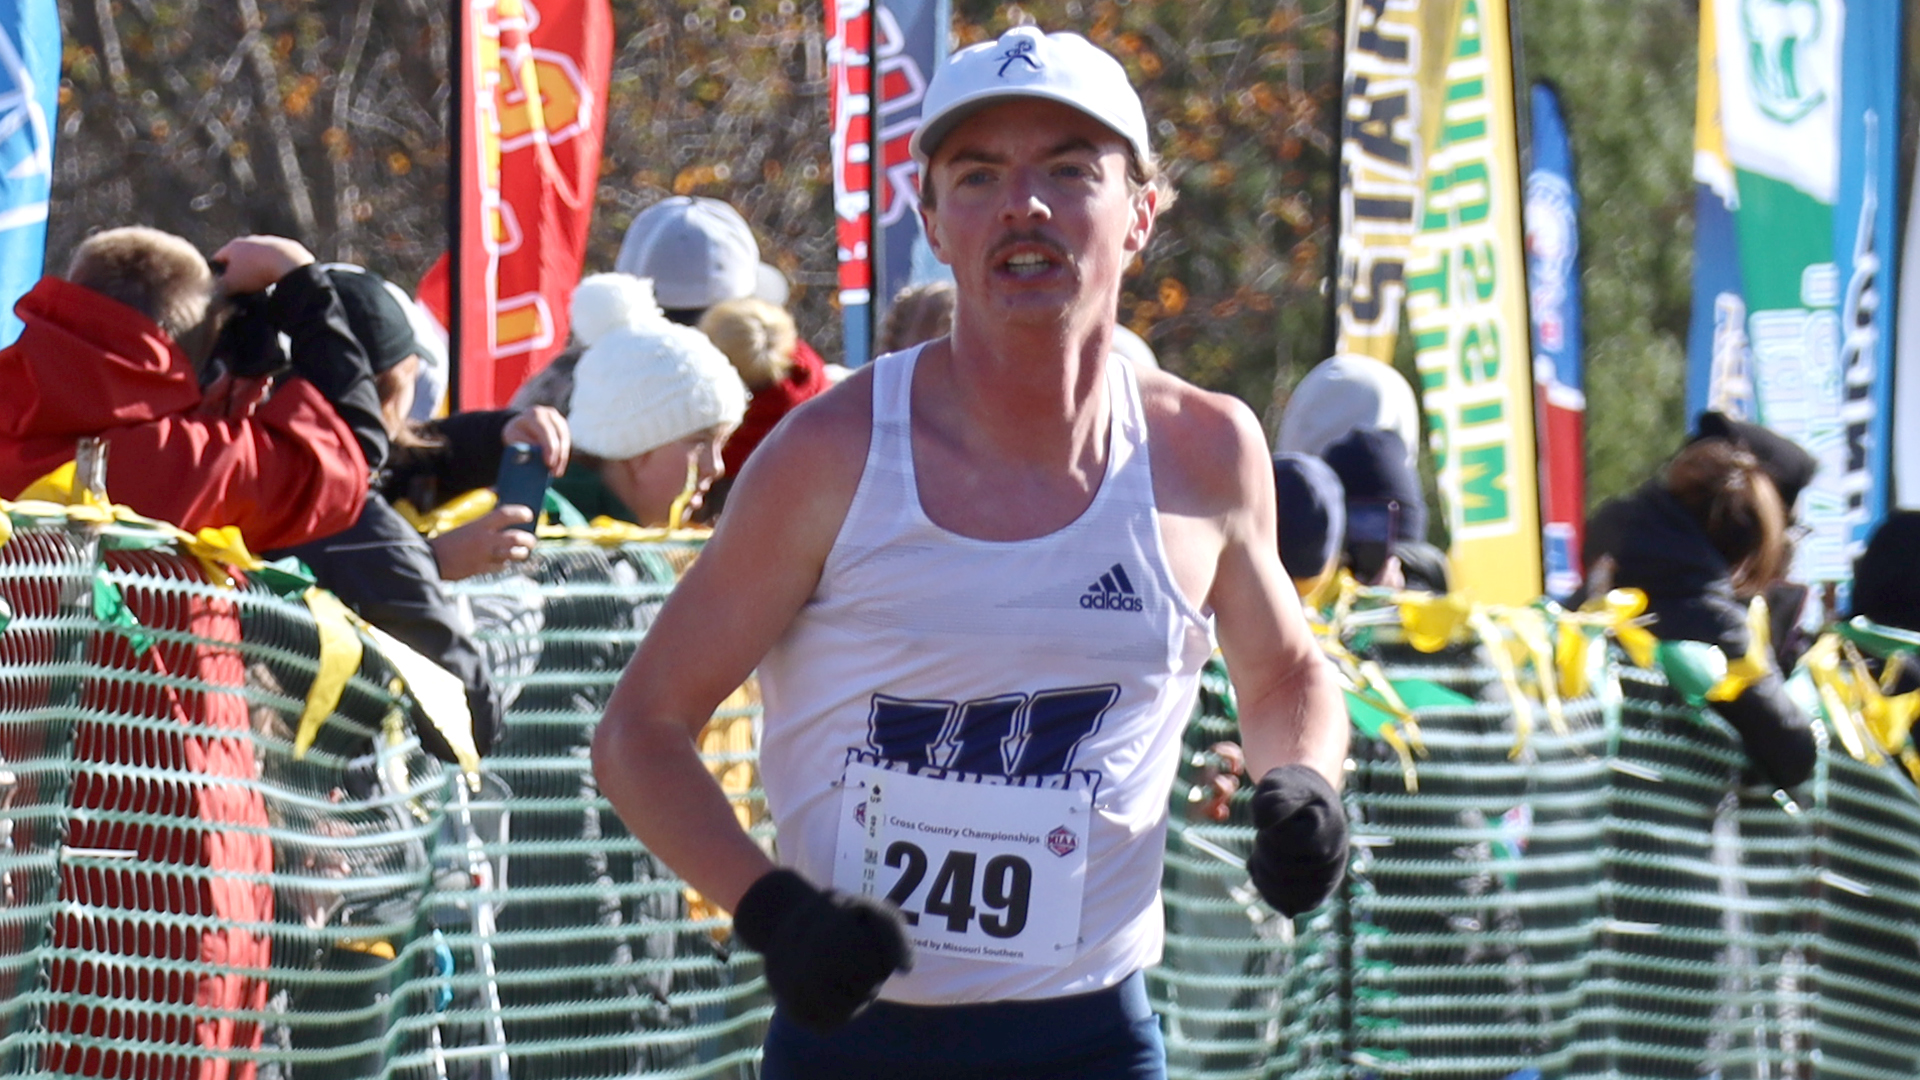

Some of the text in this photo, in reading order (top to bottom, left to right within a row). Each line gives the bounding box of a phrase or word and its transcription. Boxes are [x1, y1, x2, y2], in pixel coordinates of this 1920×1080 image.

[1079, 591, 1143, 612] adidas
[889, 816, 916, 830] Cross
[917, 822, 960, 837] Country
[961, 828, 1040, 845] Championships
[884, 841, 1032, 939] 249
[929, 940, 941, 951] by
[942, 942, 981, 954] Missouri
[983, 947, 1024, 959] Southern
